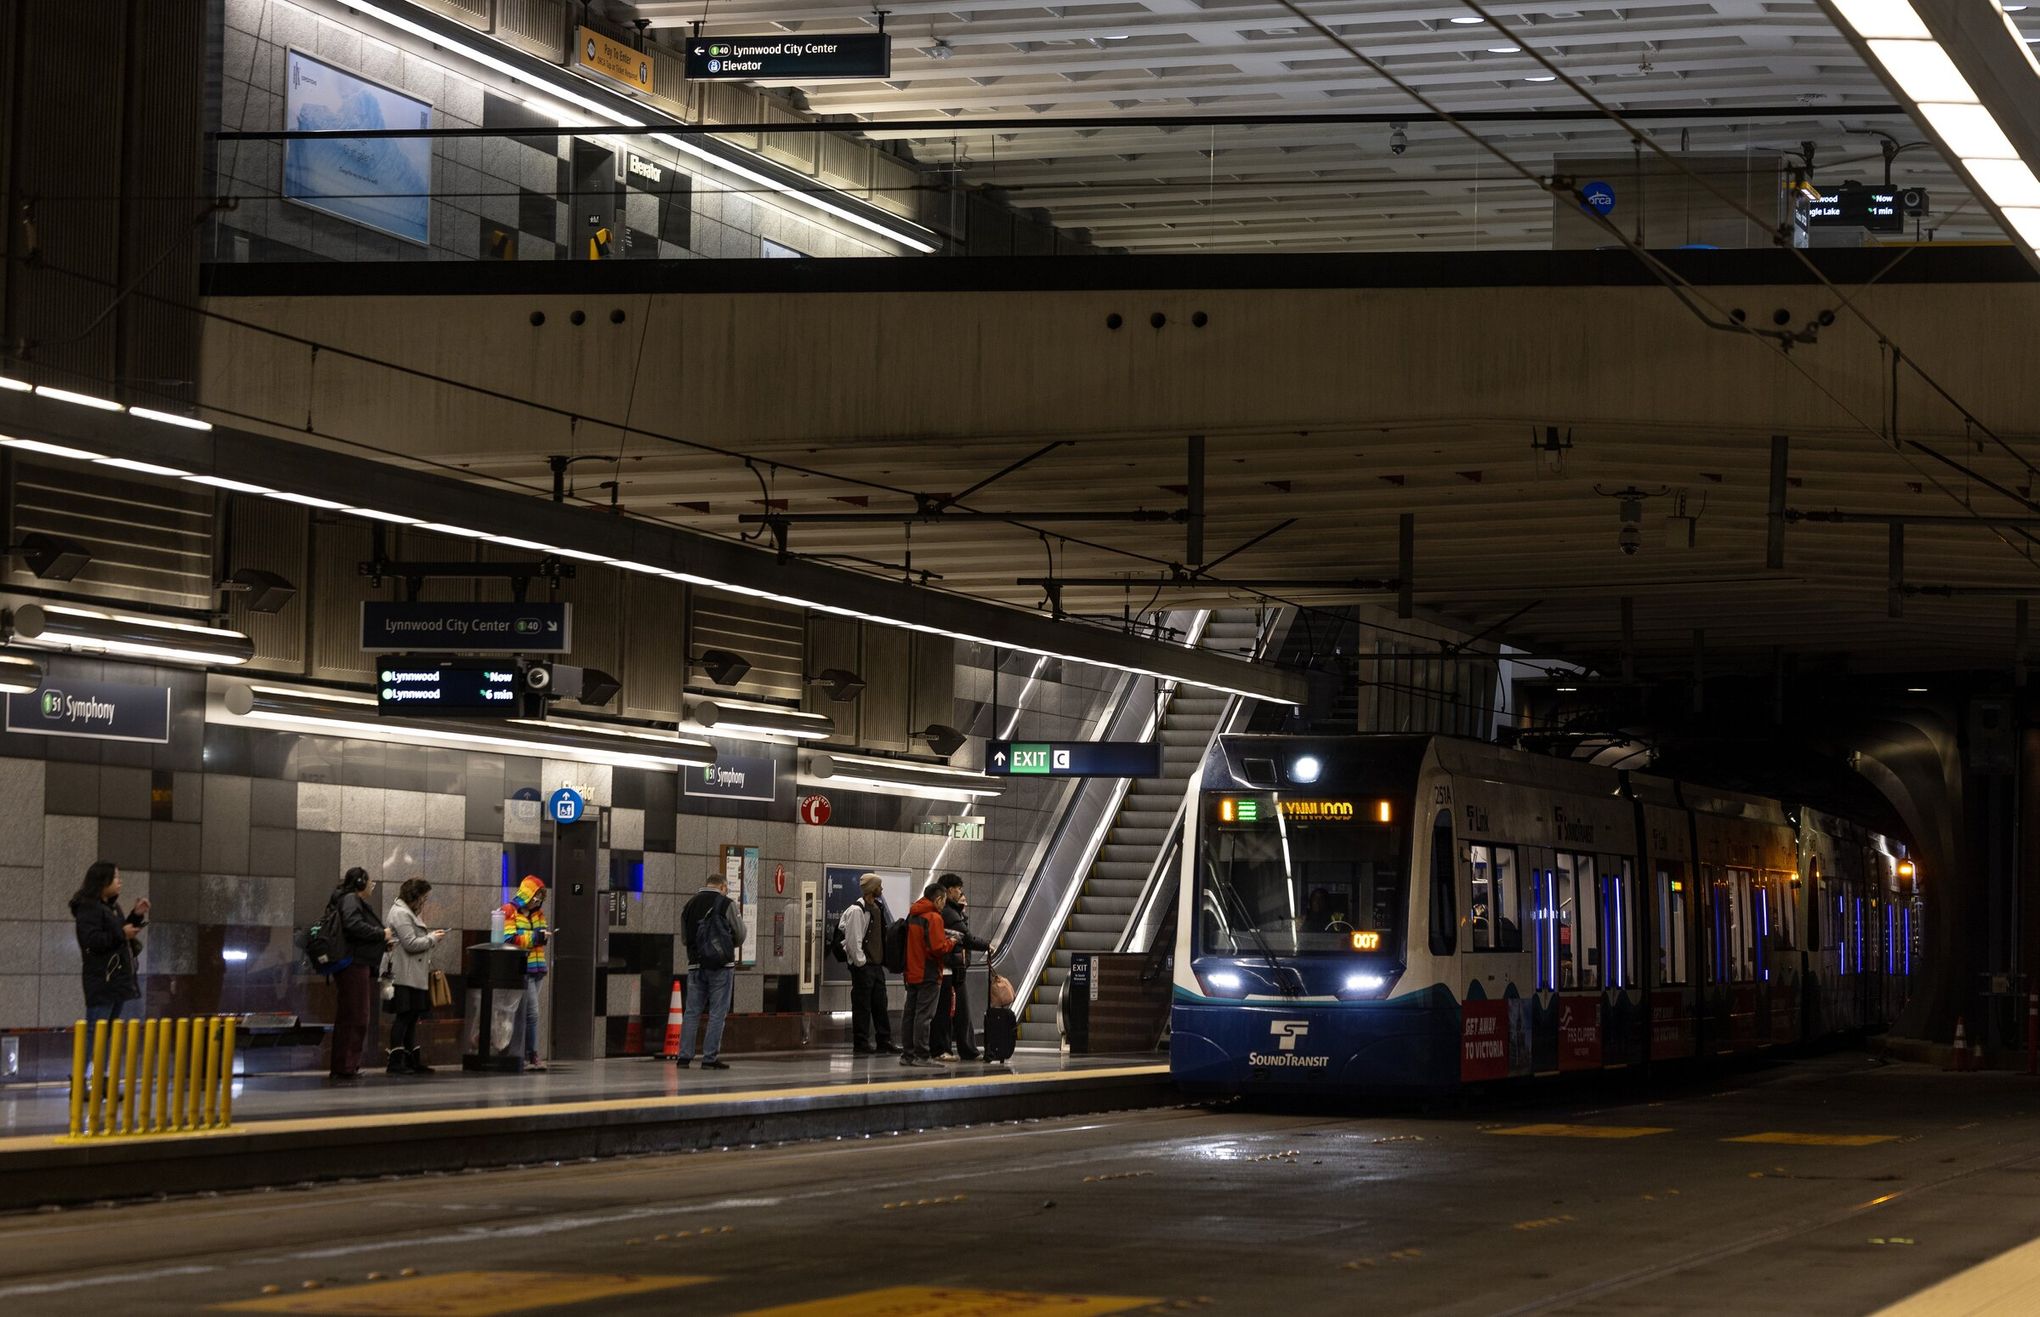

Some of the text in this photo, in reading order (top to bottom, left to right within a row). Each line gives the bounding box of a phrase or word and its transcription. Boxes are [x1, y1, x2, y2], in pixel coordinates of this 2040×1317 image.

[733, 44, 781, 57] Lynnwood
[784, 44, 803, 56] City
[805, 43, 838, 53] Center
[722, 61, 762, 71] Elevator
[630, 154, 661, 182] Elevator
[1588, 196, 1612, 205] orca
[1823, 207, 1840, 215] Lake
[1873, 207, 1877, 215] 1
[1878, 207, 1893, 215] min
[385, 618, 443, 634] Lynnwood
[446, 618, 469, 634] City
[471, 619, 510, 631] Center
[527, 621, 539, 631] 40
[392, 671, 513, 683] Lynnwood Now
[392, 689, 513, 701] Lynnwood 6 min
[52, 698, 62, 712] 51
[65, 694, 116, 726] Symphony
[1013, 751, 1065, 767] EXIT C
[717, 766, 745, 788] Symphony
[802, 794, 830, 807] EMERGENCY
[953, 822, 982, 839] EXIT
[1353, 933, 1379, 948] 007
[1072, 964, 1088, 972] EXIT
[1465, 1017, 1497, 1035] GET AWAY
[1465, 1040, 1504, 1060] TO VICTORIA
